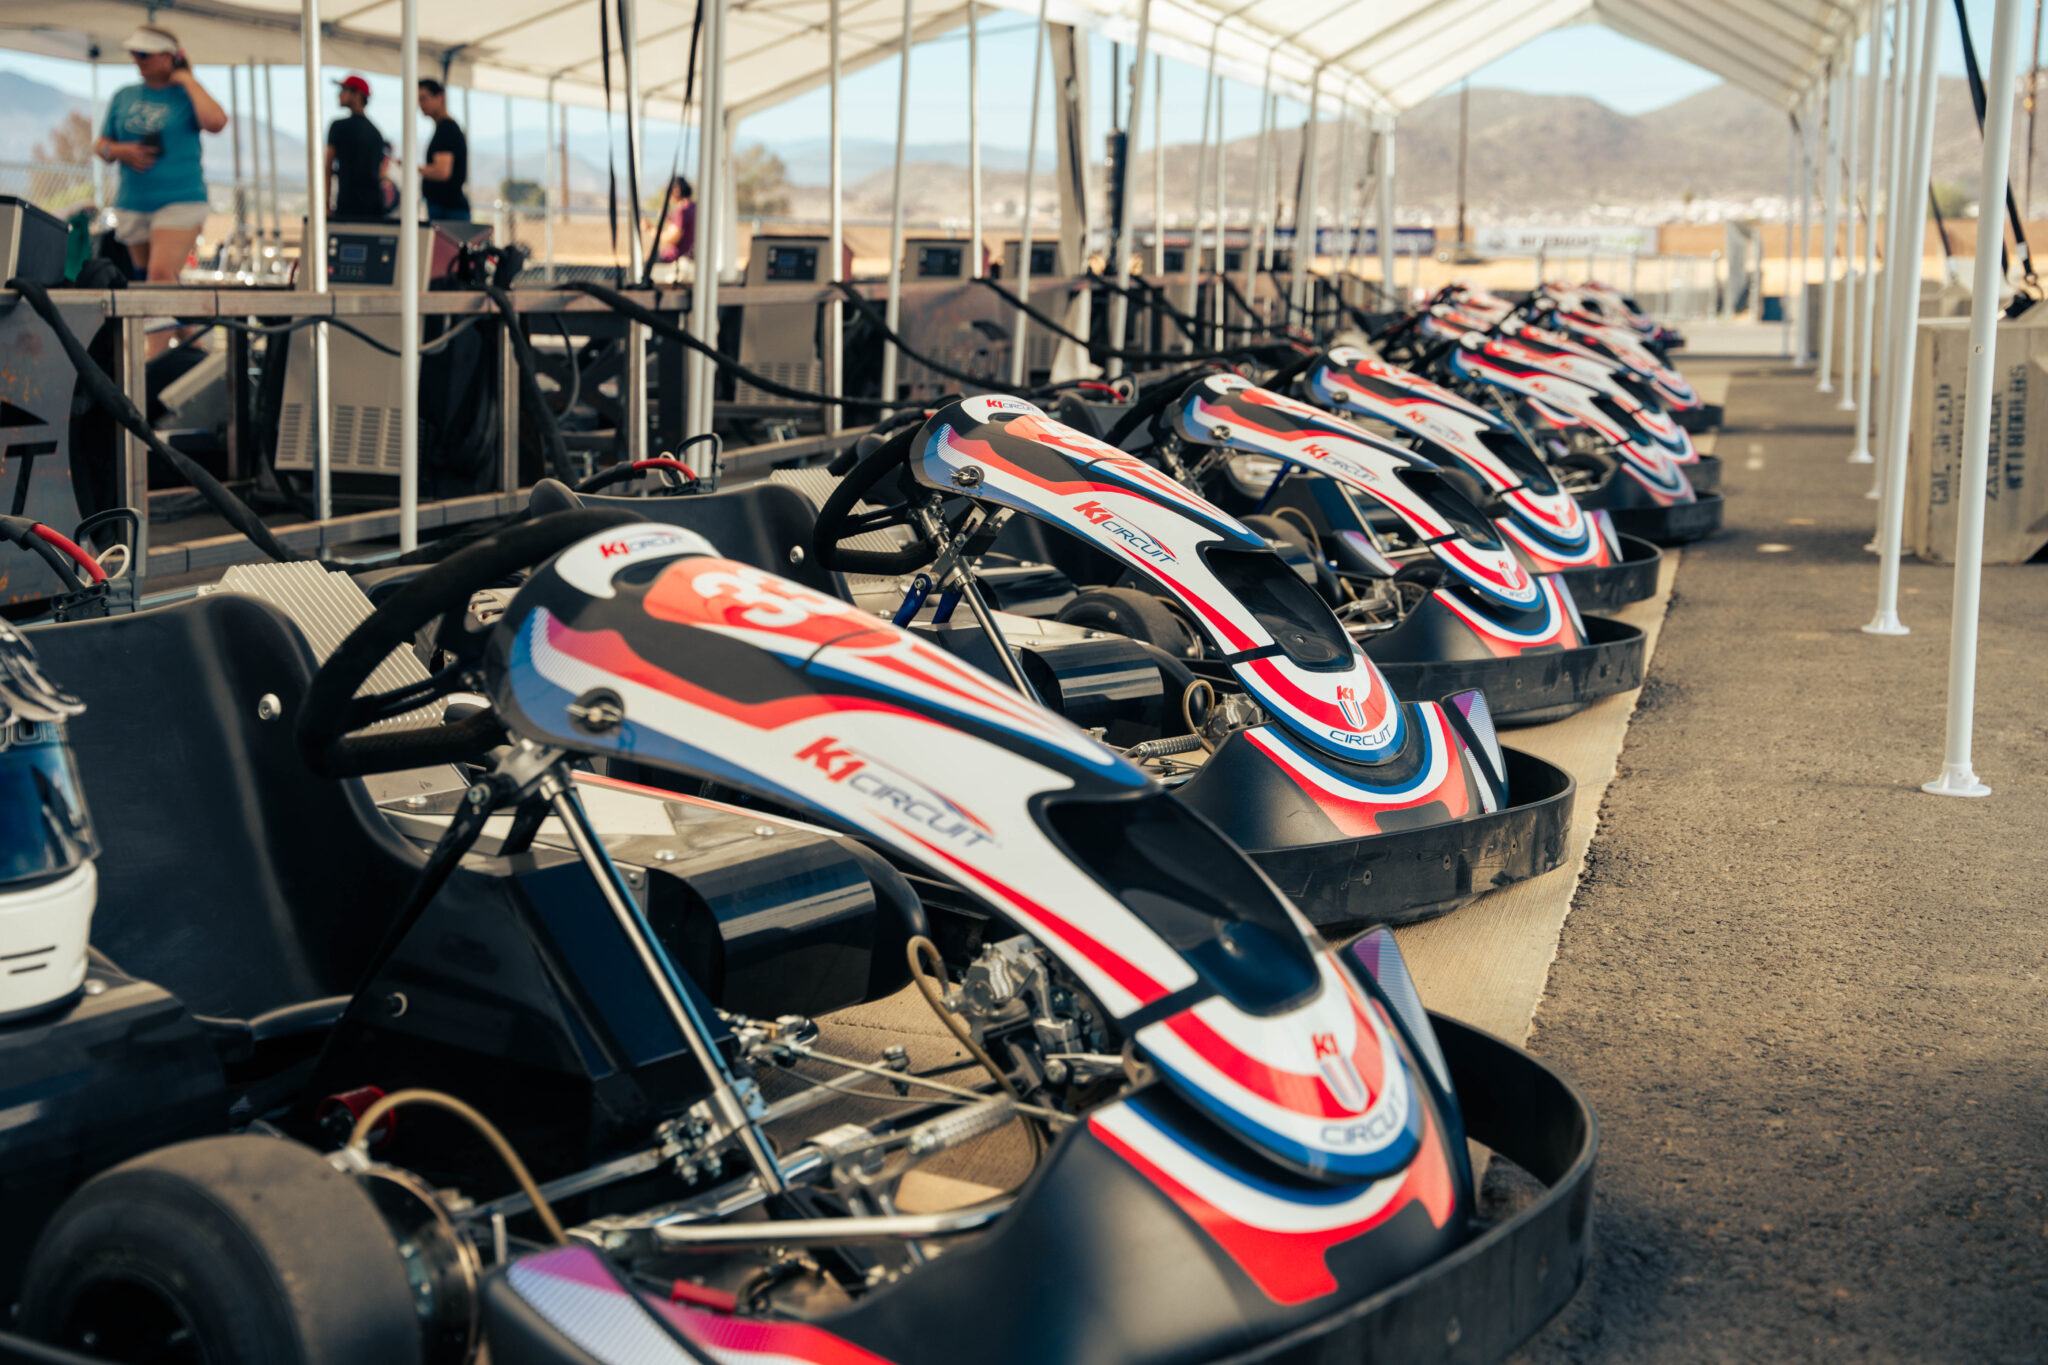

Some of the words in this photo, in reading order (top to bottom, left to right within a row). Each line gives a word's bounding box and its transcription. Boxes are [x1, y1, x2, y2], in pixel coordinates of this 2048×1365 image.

[986, 399, 1004, 408] K1
[1301, 444, 1331, 460] K1
[1073, 500, 1114, 525] K1
[1102, 520, 1176, 562] CIRCUIT
[600, 540, 630, 559] K1
[1336, 685, 1355, 701] K1
[1329, 723, 1391, 745] CIRCUIT
[794, 736, 867, 783] K1
[849, 772, 995, 847] CIRCUIT
[1311, 1032, 1339, 1062] K1
[1320, 1081, 1402, 1146] CIRCUIT
